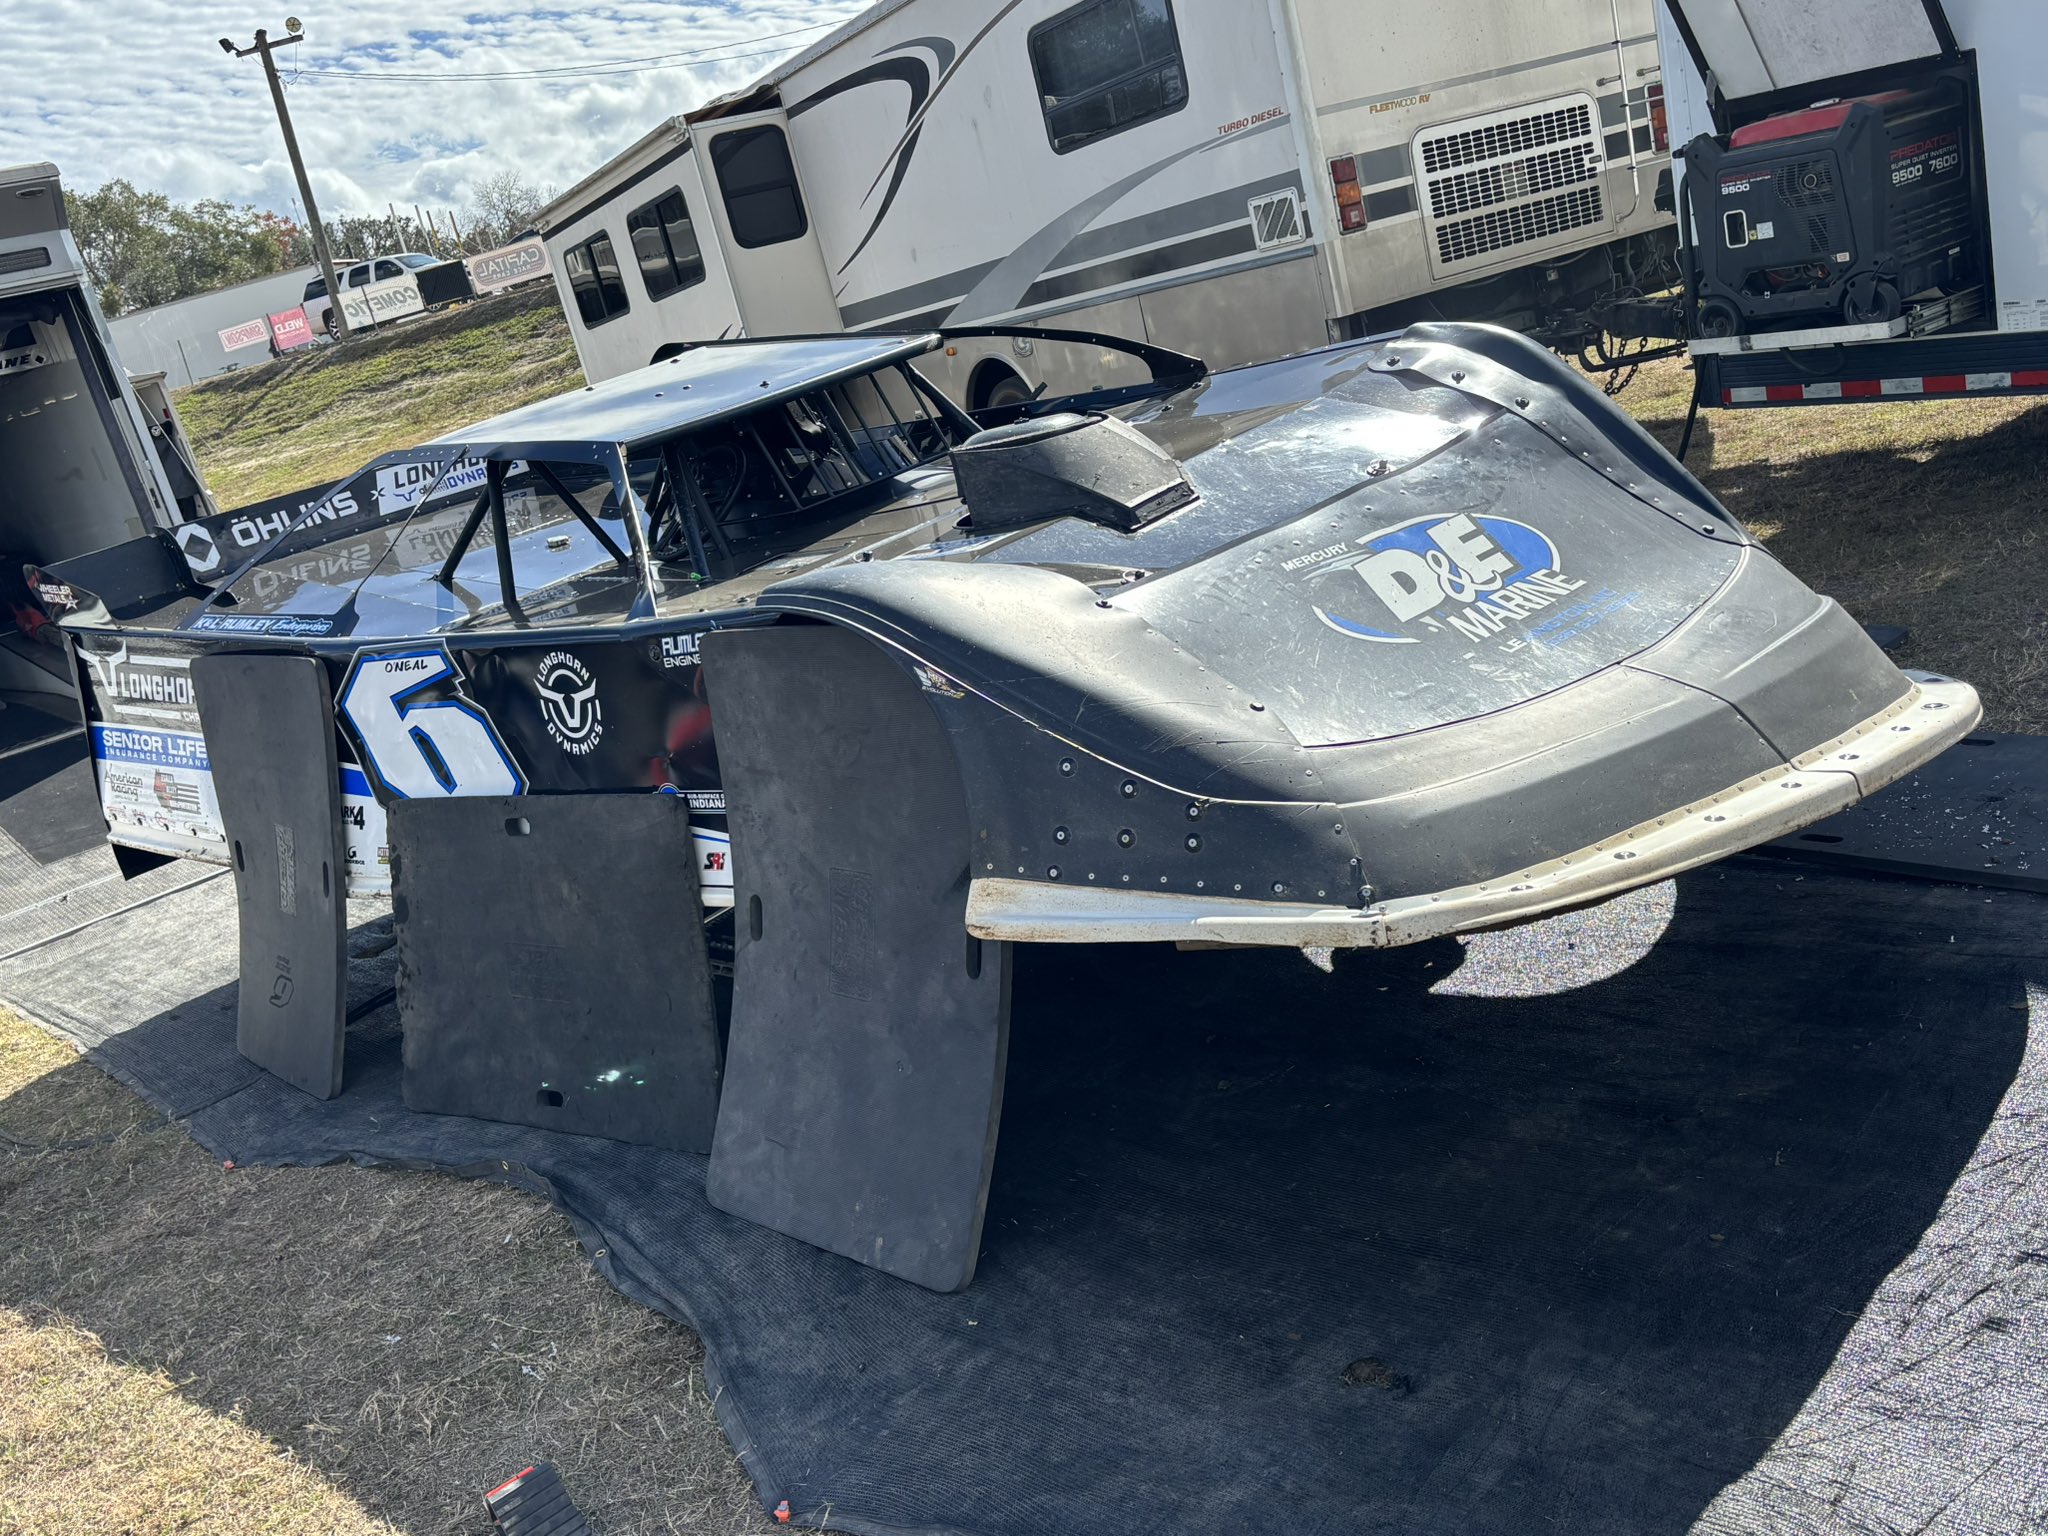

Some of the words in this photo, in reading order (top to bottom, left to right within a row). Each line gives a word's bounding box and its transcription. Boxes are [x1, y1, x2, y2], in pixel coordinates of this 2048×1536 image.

[1369, 97, 1417, 114] FLEETWOOD
[1419, 94, 1431, 104] RV
[1217, 118, 1249, 135] TURBO
[1251, 106, 1284, 125] DIESEL
[1891, 160, 1911, 170] SUPER
[1912, 153, 1928, 164] QUIET
[1930, 144, 1957, 158] INVERTER
[1892, 164, 1923, 184] 9500
[1929, 153, 1958, 172] 7600
[1721, 183, 1750, 195] 9500
[1280, 541, 1349, 572] MERCURY
[1353, 513, 1515, 622] D&E
[39, 584, 71, 594] WHEELER
[43, 593, 69, 604] METALS
[1447, 567, 1588, 643] MARINE
[194, 617, 220, 629] K&L
[219, 617, 275, 631] RUMLEY
[272, 620, 329, 633] Enterprises
[385, 659, 428, 673] O'NEAL
[537, 651, 590, 682] LONGHORN
[922, 685, 954, 697] EVOLUTION
[341, 650, 522, 799] 6
[102, 729, 163, 753] SENIOR
[168, 738, 207, 759] LIFE
[547, 722, 603, 755] DYNAMICS
[105, 747, 158, 761] INSURANCE
[161, 754, 209, 767] COMPANY
[104, 764, 143, 786] American
[111, 784, 139, 802] Racing
[353, 806, 365, 831] 4
